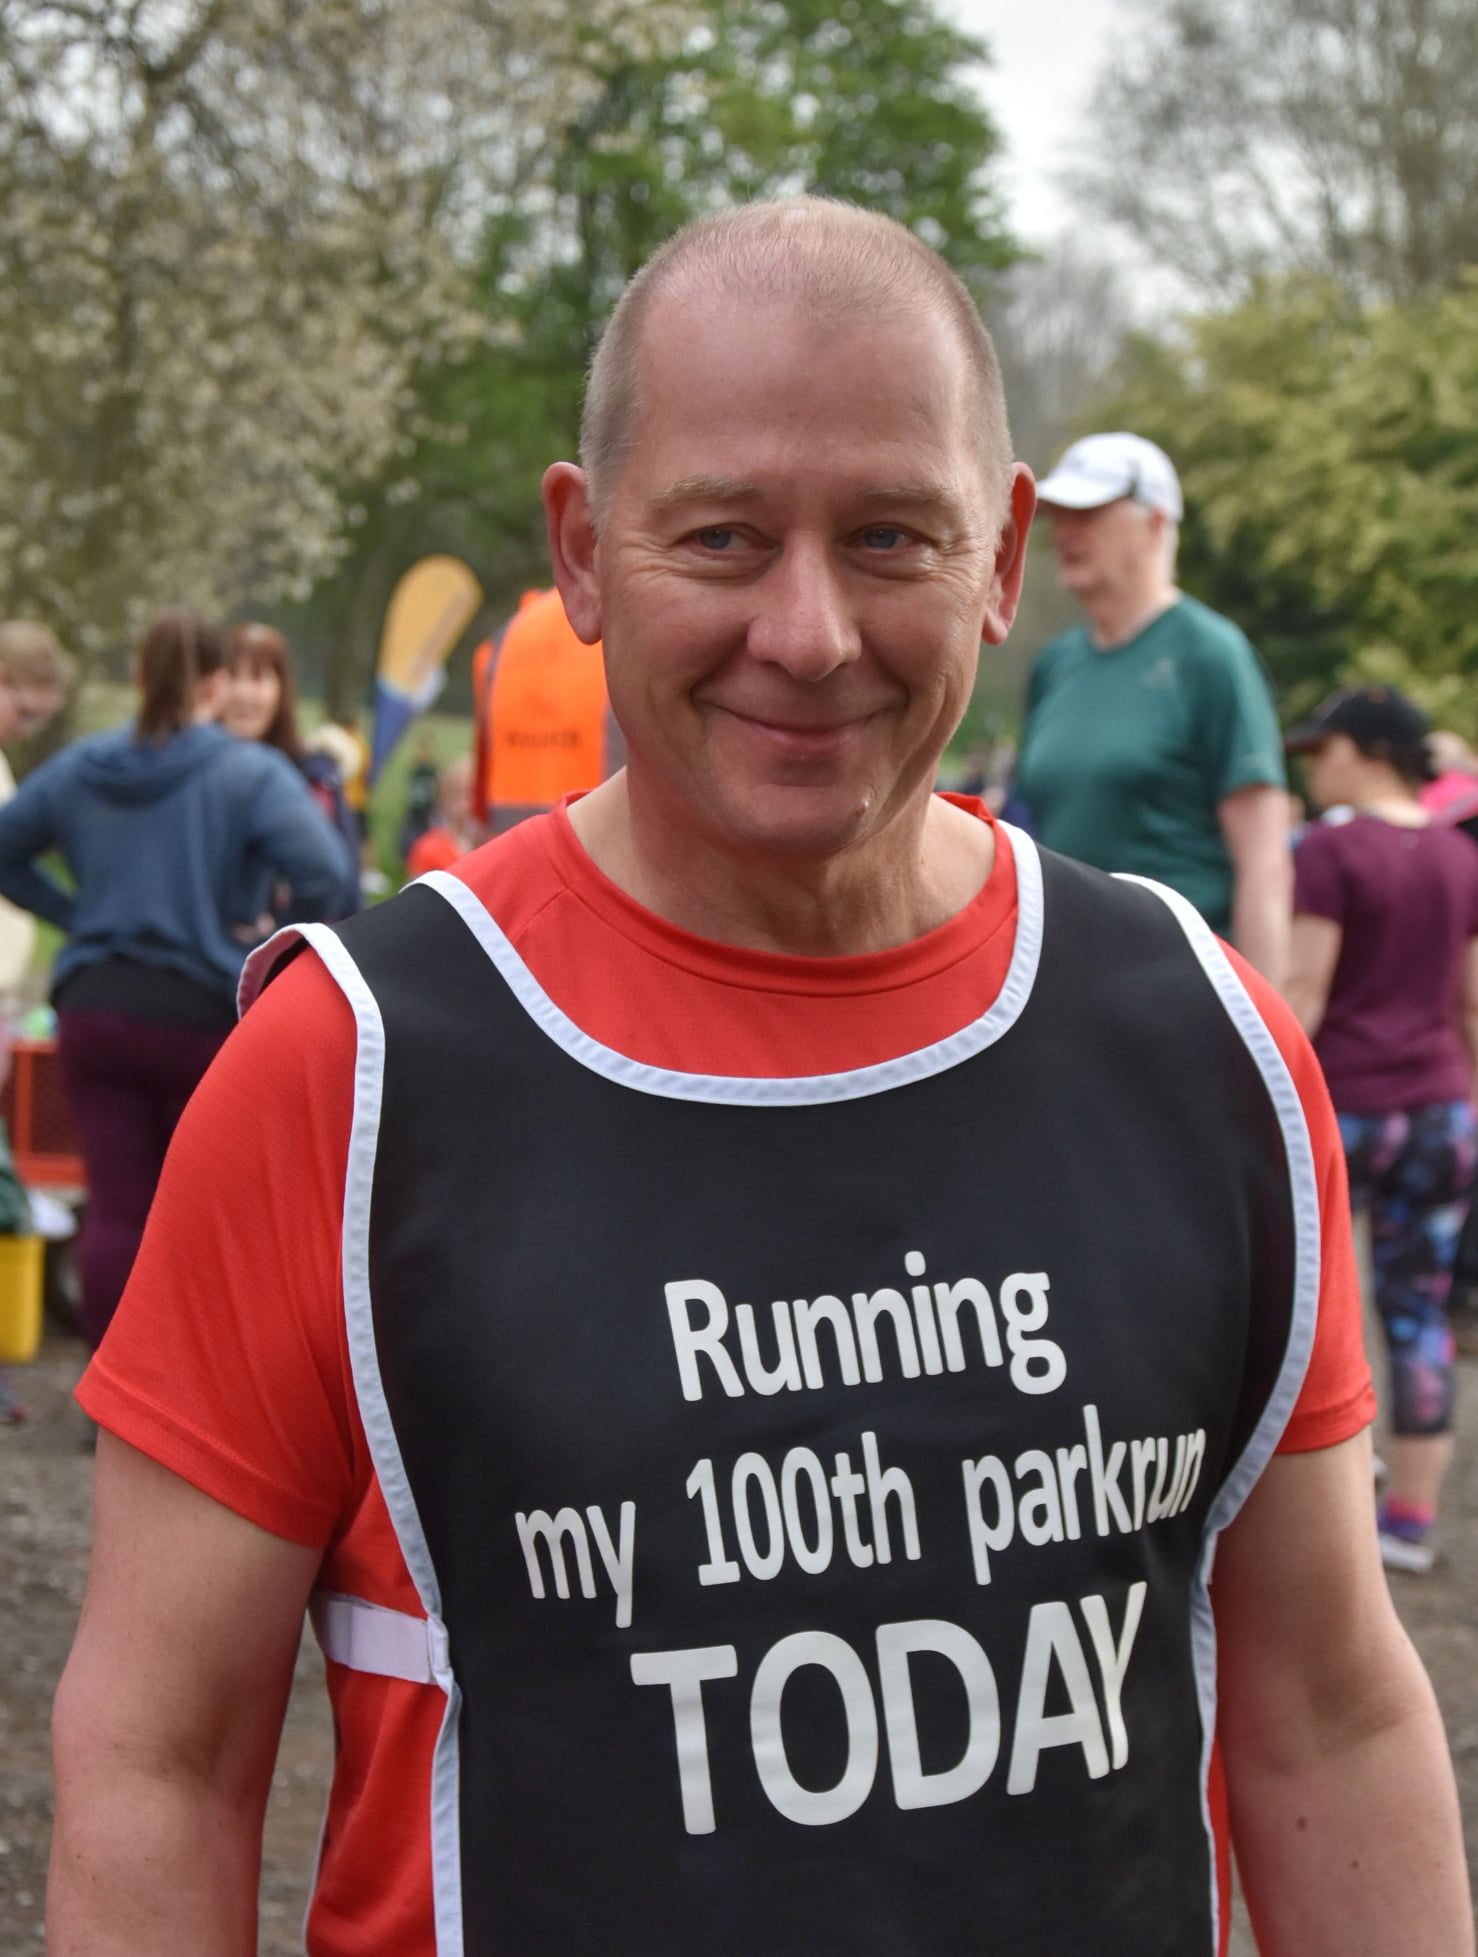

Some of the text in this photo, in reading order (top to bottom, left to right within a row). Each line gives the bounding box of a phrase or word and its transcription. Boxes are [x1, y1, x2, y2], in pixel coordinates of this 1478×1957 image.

[664, 1250, 1067, 1401] Running
[515, 1404, 1206, 1628] my 100th parkrun
[630, 1582, 1148, 1834] TODAY
